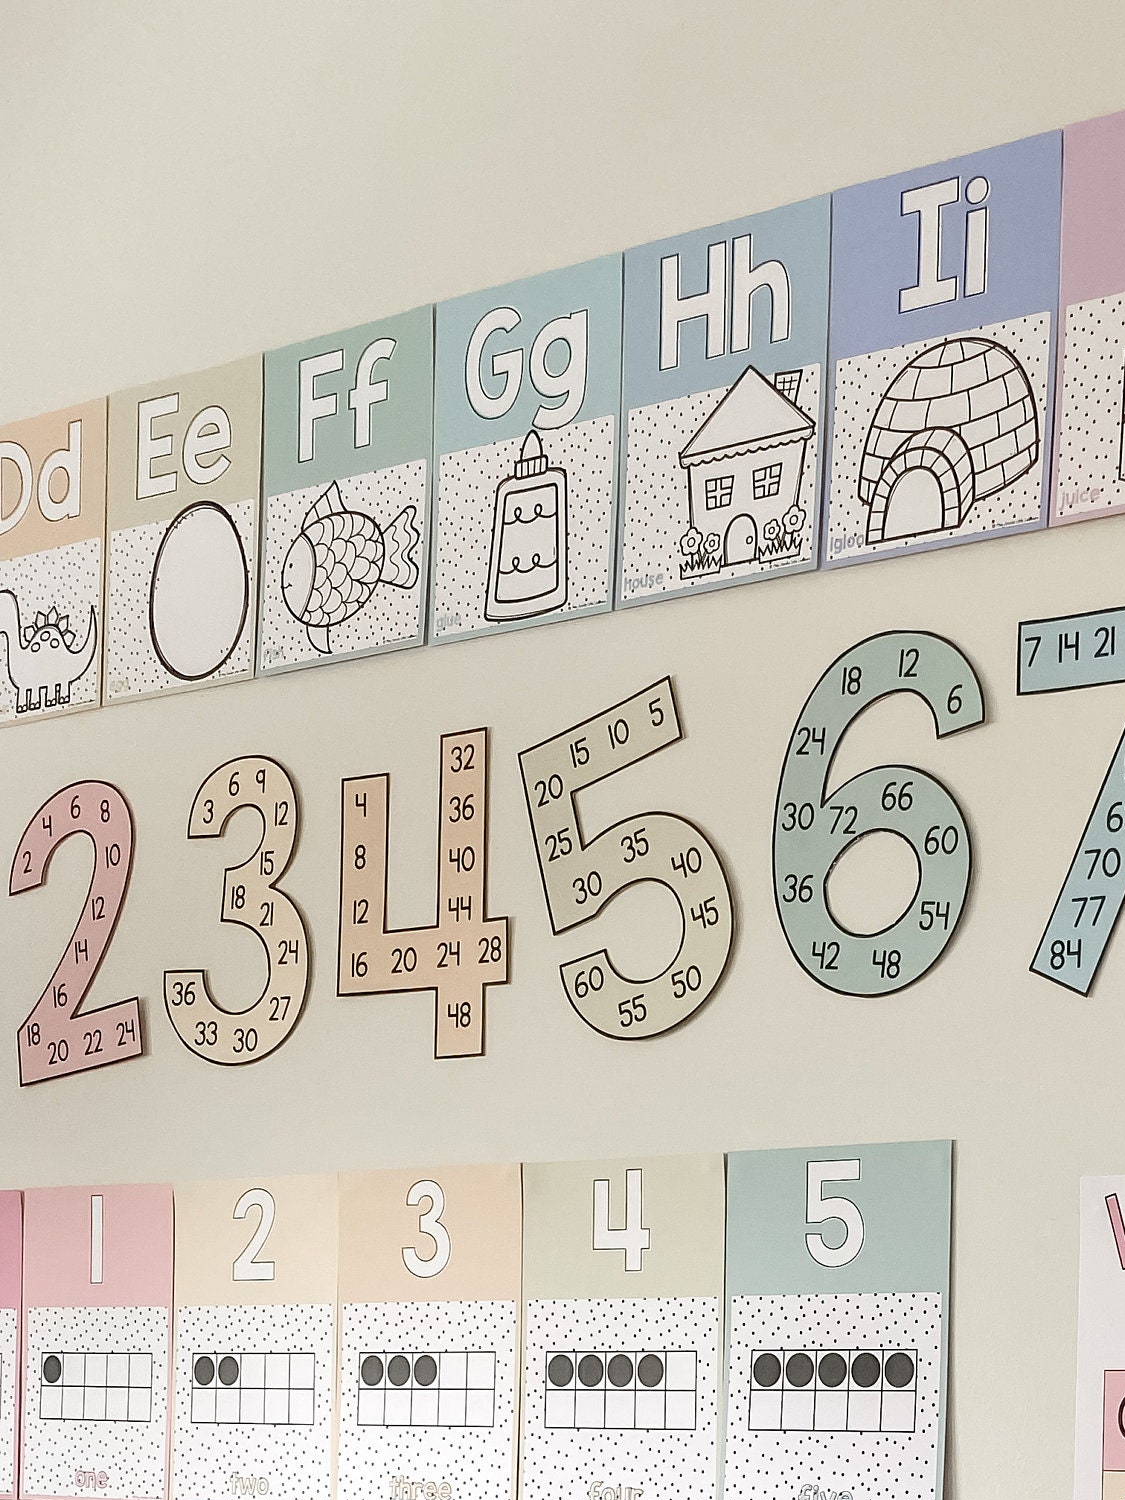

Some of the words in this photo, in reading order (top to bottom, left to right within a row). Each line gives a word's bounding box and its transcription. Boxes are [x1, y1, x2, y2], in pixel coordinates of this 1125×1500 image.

[899, 176, 990, 314] Ii
[659, 234, 790, 371] Hh
[465, 306, 589, 431] Gg
[298, 337, 398, 462] Ff
[136, 392, 232, 501] Ee
[1059, 489, 1100, 510] juice
[624, 573, 663, 592] house
[1025, 637, 1041, 666] 7
[1059, 632, 1079, 663] 14
[1094, 627, 1115, 657] 21
[842, 667, 861, 695] 18
[649, 698, 664, 726] 5
[947, 685, 962, 714] 6
[570, 738, 590, 768] 15
[608, 719, 629, 749] 10
[256, 769, 265, 793] 9
[70, 795, 80, 819] 6
[356, 792, 366, 817] 4
[882, 782, 913, 810] 66
[203, 800, 213, 824] 3
[772, 629, 986, 997] 6
[782, 802, 814, 831] 30
[105, 844, 120, 868] 10
[355, 845, 366, 869] 8
[518, 675, 734, 1040] 5
[545, 828, 573, 861] 25
[621, 828, 649, 863] 35
[23, 851, 32, 874] 2
[260, 852, 274, 875] 15
[337, 727, 509, 1059] 4
[163, 754, 310, 1067] 3
[260, 902, 273, 926] 21
[353, 900, 369, 925] 12
[691, 897, 719, 928] 45
[919, 902, 949, 930] 54
[9, 779, 143, 1087] 2
[75, 939, 87, 964] 14
[351, 952, 367, 977] 16
[391, 947, 417, 973] 20
[437, 941, 460, 967] 24
[478, 936, 501, 964] 28
[812, 942, 840, 969] 42
[1050, 939, 1081, 969] 84
[269, 996, 290, 1020] 27
[28, 1023, 40, 1046] 18
[116, 1020, 135, 1046] 24
[195, 1022, 218, 1045] 33
[593, 1168, 650, 1272] 4
[805, 1158, 864, 1268] 5
[90, 1195, 103, 1284] 1
[232, 1188, 275, 1281] 2
[402, 1180, 451, 1278] 3
[75, 1469, 108, 1489] one
[229, 1473, 270, 1496] two
